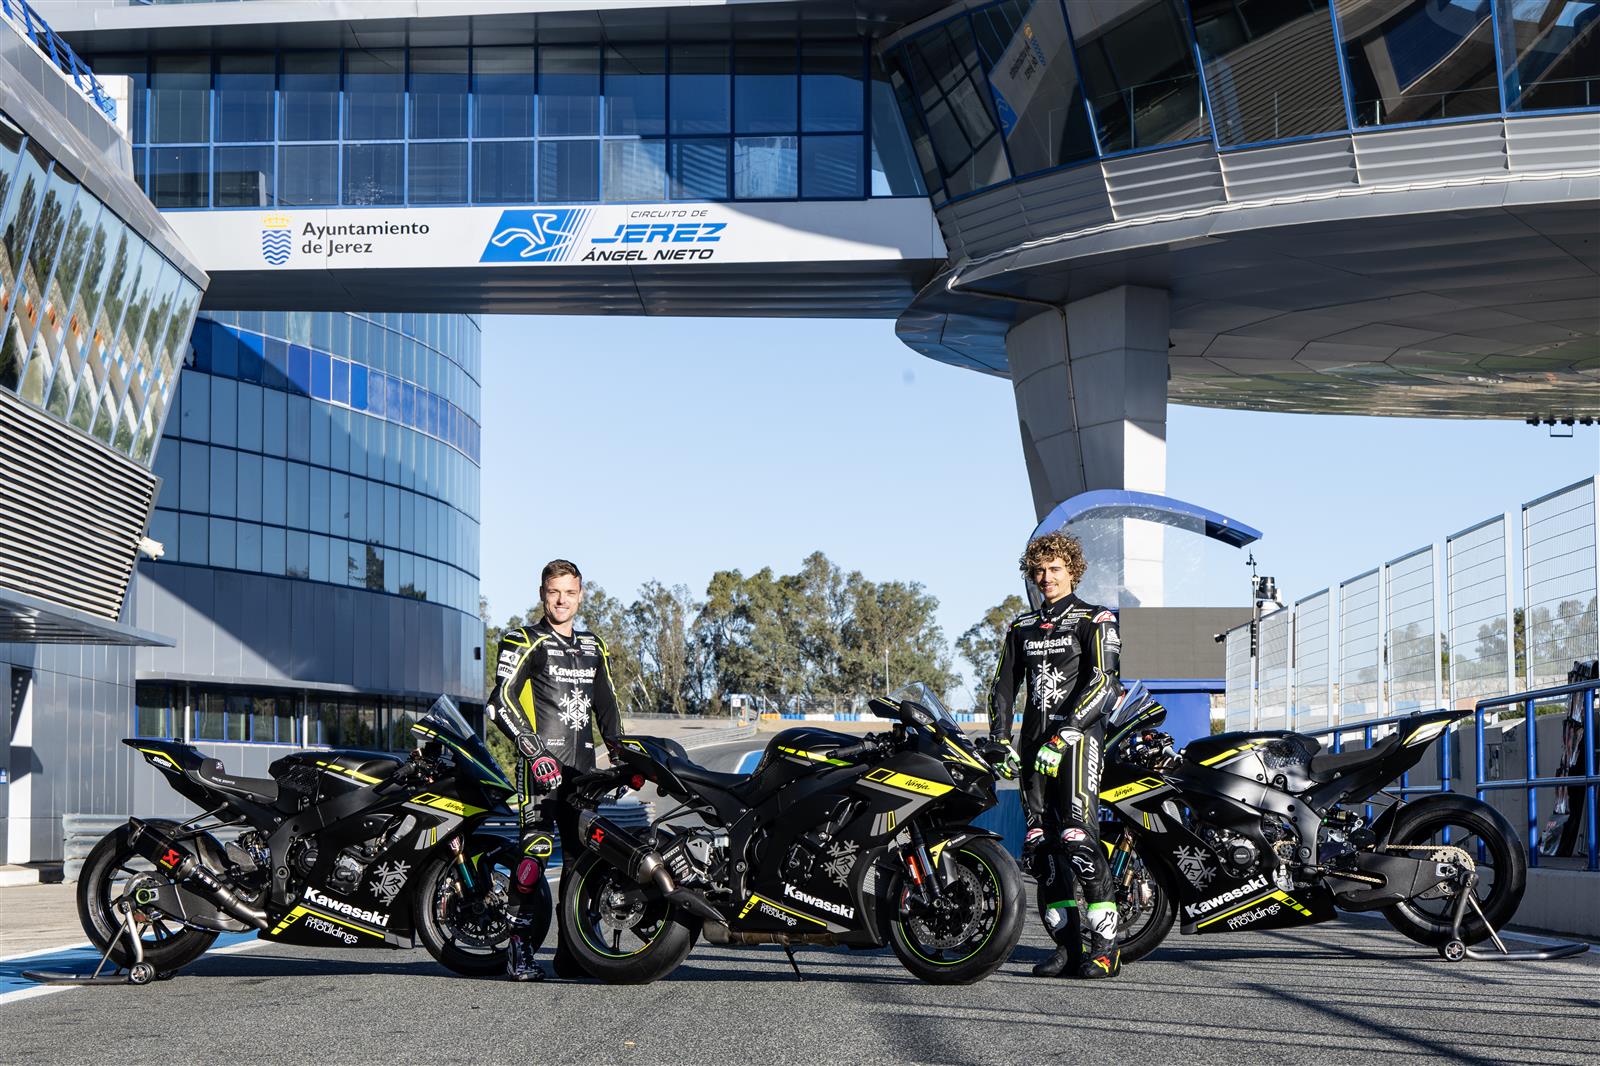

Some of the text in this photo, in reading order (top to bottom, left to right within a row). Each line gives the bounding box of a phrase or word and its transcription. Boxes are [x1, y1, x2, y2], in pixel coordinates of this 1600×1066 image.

[630, 209, 709, 218] CIRCUITO DE
[302, 220, 430, 240] Ayuntamiento
[591, 222, 728, 244] JEREZ
[301, 239, 373, 257] de Jerez
[581, 247, 714, 262] ÁNGEL NIETO
[1024, 635, 1073, 651] Kawasaki
[1048, 647, 1066, 655] Team
[548, 664, 597, 678] Kawasak
[152, 755, 173, 768] SHOWA
[1087, 735, 1099, 796] SHOWA
[905, 779, 930, 790] Ninja
[784, 883, 855, 920] Kawasaki
[1184, 873, 1269, 918] Kawasaki
[303, 886, 391, 928] Kawasaki
[760, 904, 798, 927] mouldings
[1228, 902, 1281, 931] mouldings
[304, 917, 359, 944] mouldings
